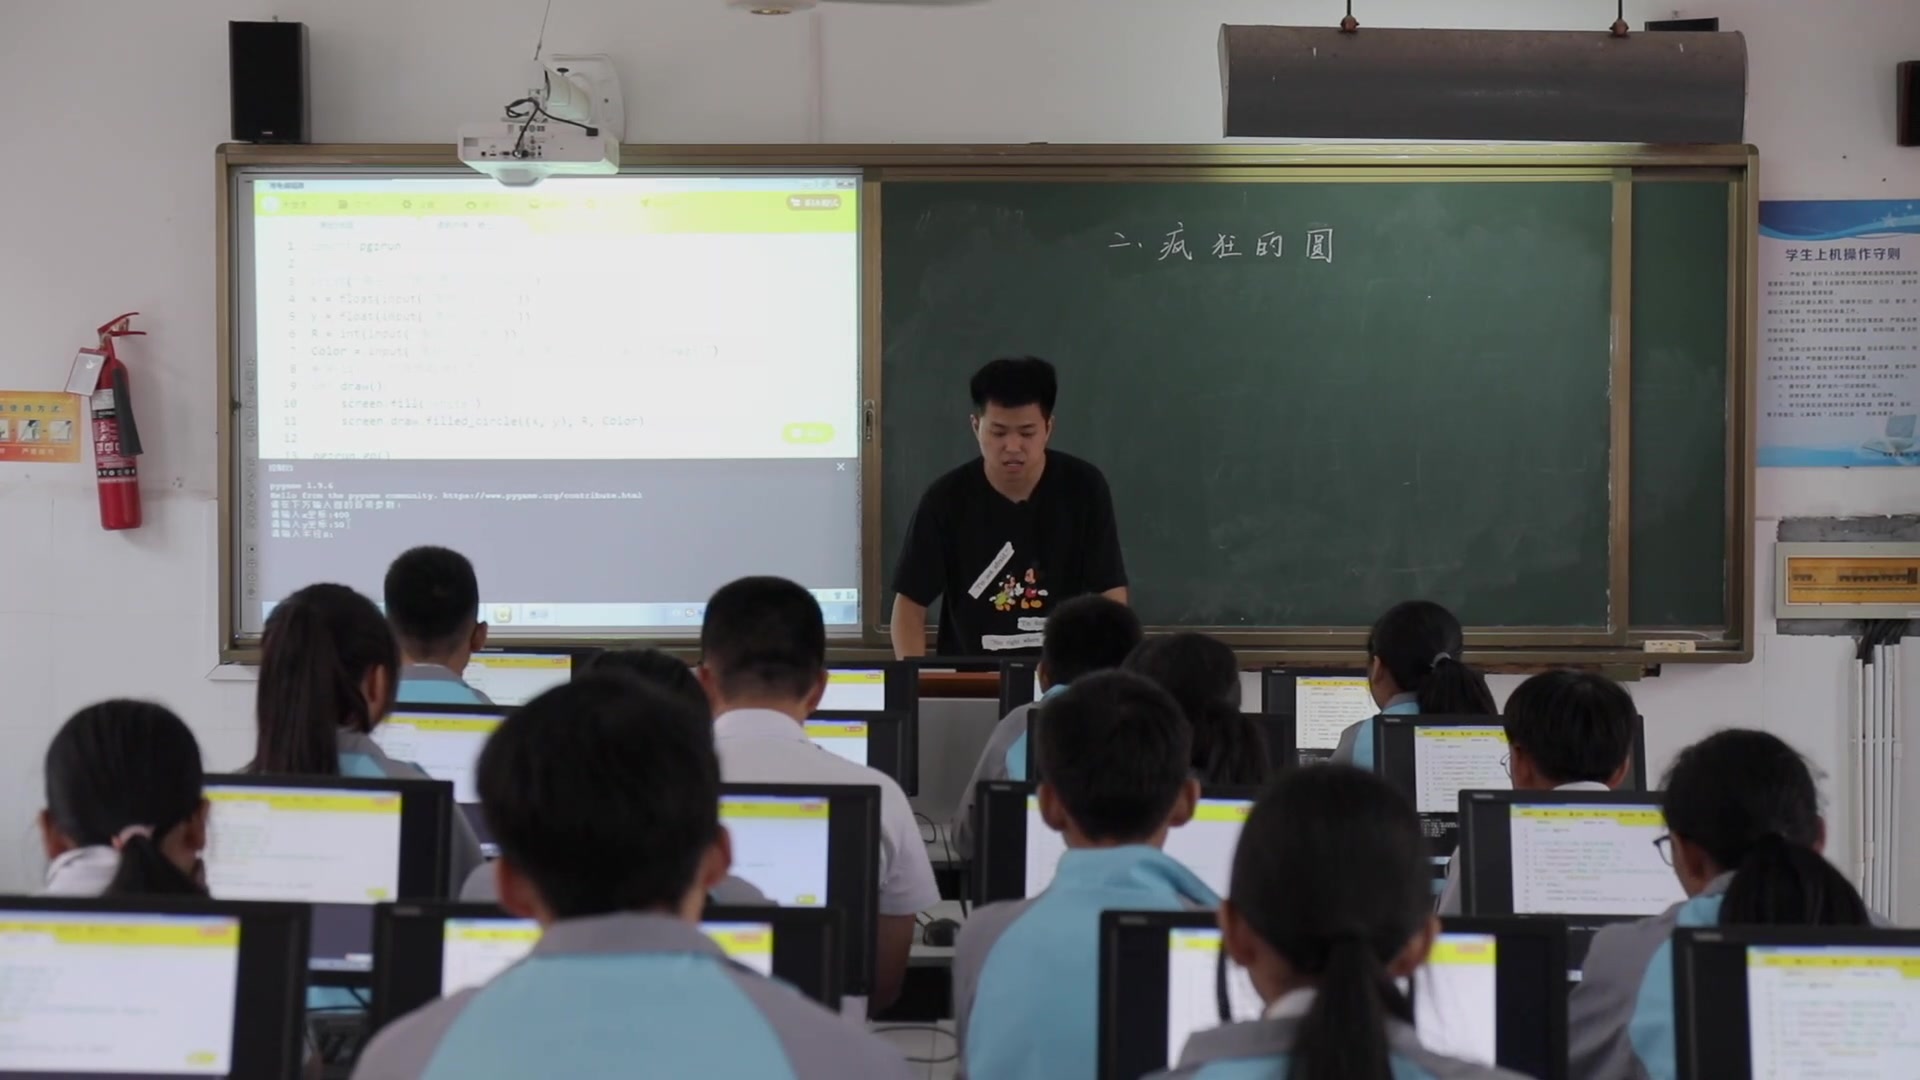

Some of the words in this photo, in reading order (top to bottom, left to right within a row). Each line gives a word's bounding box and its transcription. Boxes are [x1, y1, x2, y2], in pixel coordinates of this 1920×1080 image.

[1785, 247, 1901, 262] 学生上机操作守则
[270, 482, 302, 492] pygame
[306, 481, 334, 490] 1.9.6
[270, 491, 298, 500] Hello
[302, 491, 324, 500] from
[328, 491, 345, 500] the
[348, 492, 380, 502] pygame
[385, 491, 438, 502] community.
